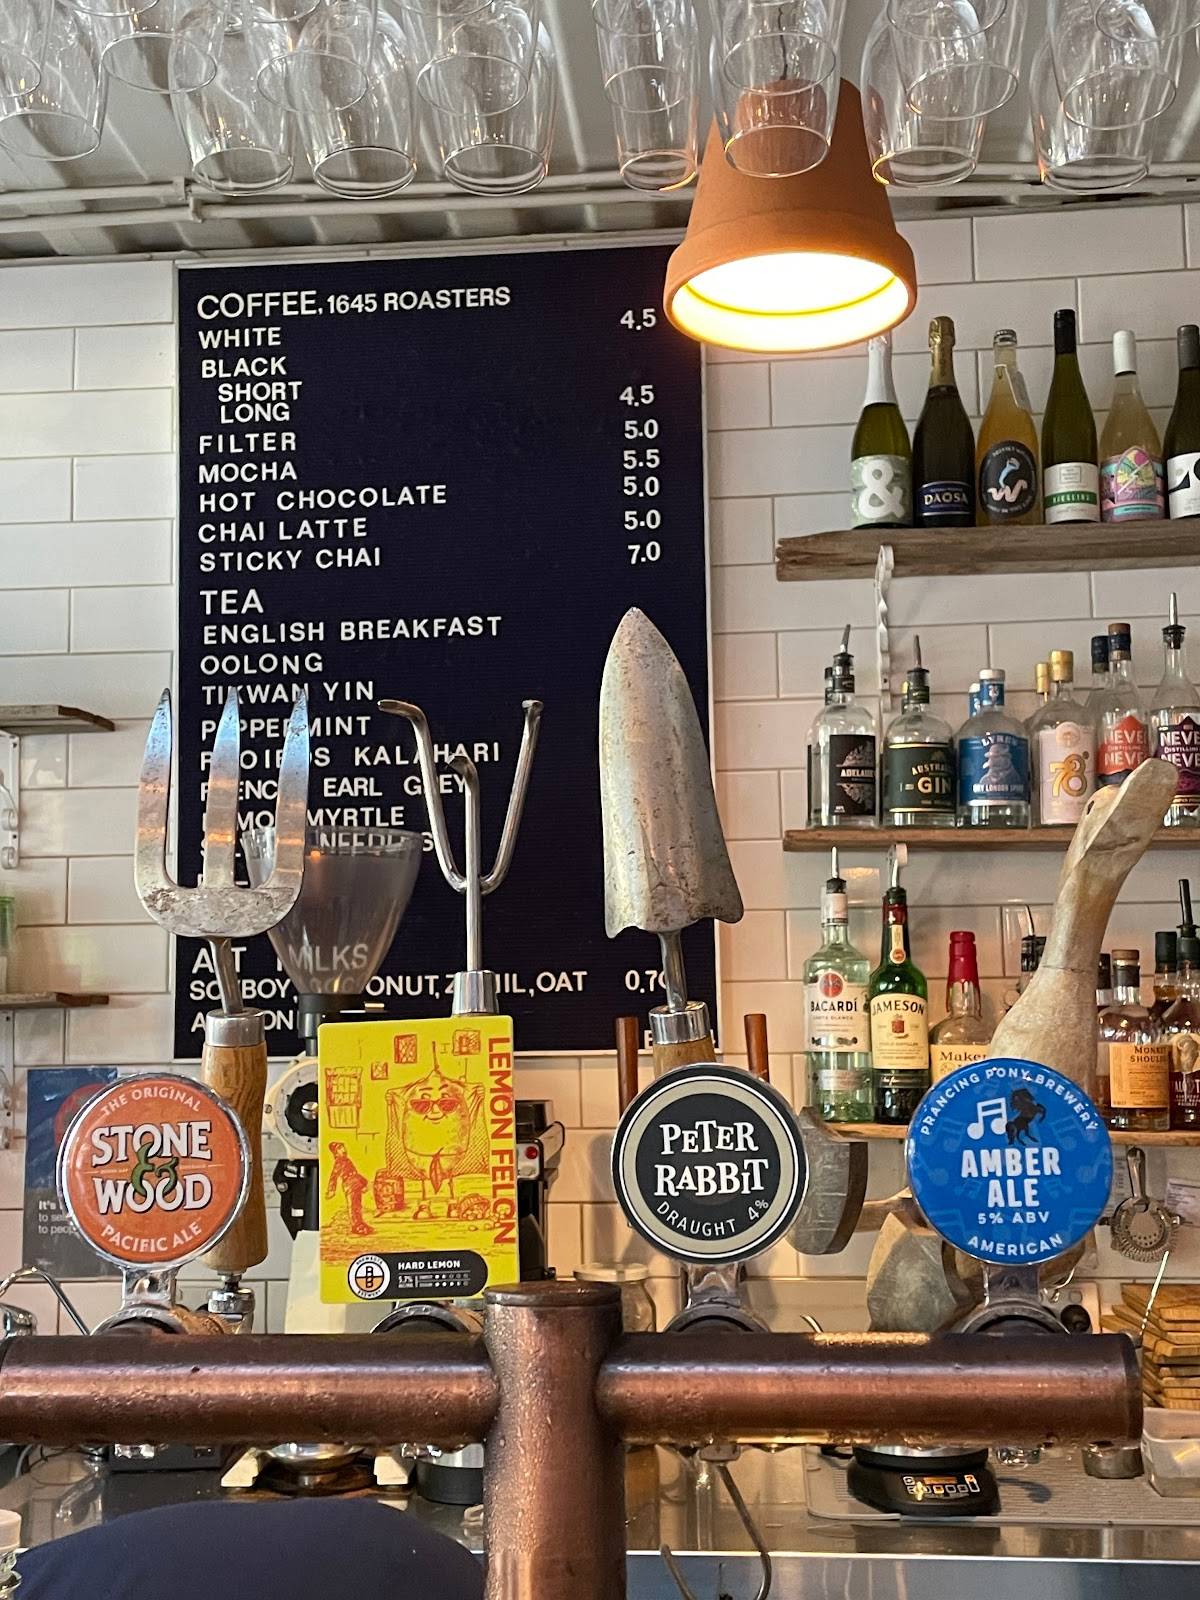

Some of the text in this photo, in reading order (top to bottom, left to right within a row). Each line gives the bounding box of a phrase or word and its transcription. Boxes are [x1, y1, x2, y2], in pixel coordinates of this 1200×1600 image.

[327, 294, 377, 313] 1645
[384, 287, 510, 311] ROASTERS
[621, 309, 655, 330] 4.5
[199, 327, 281, 349] WHITE
[202, 357, 286, 378] BLACK
[218, 381, 302, 401] SHORT
[620, 385, 654, 406] 4.5
[221, 403, 289, 423] LONG
[625, 419, 658, 439] 5.0
[200, 432, 295, 454] FILTER
[624, 449, 659, 469] 5.5
[199, 461, 297, 483] MOCHA
[624, 476, 659, 497] 5.0
[200, 485, 446, 512] HOT CHOCOLATE
[923, 492, 970, 505] DAOSA
[199, 518, 366, 543] CHAI LATTE
[625, 510, 660, 530] 5.0
[200, 548, 379, 571] STICKY CHAI
[628, 542, 660, 564] 7.0
[200, 589, 263, 614] TEA
[204, 616, 501, 644] ENGLISH BREAKFAST
[201, 653, 322, 674] OOLONG
[323, 681, 373, 701] YIN
[201, 714, 372, 741] PPEMINT
[1104, 729, 1147, 745] NEVE
[200, 746, 331, 771] ROIS
[200, 773, 467, 802] FNC EARL GEY
[917, 776, 951, 794] GIN
[306, 806, 405, 828] MYRTLE
[191, 946, 248, 974] AT
[189, 978, 299, 1003] SOBOY,
[872, 1000, 925, 1016] JAMESON
[488, 1037, 513, 1140] LEMON
[101, 1086, 201, 1116] THE ORIGINAL
[920, 1073, 980, 1136] PRANCING
[1035, 1073, 1099, 1132] BREWERY
[91, 1120, 212, 1168] STONE
[961, 1147, 1062, 1178] AMBER
[91, 1173, 212, 1215] WOOD
[987, 1178, 1040, 1208] ALE
[656, 1199, 770, 1237] DRAUGHT 4%
[1012, 1211, 1050, 1224] ABV
[101, 1220, 203, 1253] PACIFIC ALE
[967, 1233, 1063, 1256] AMERICAN
[397, 1260, 461, 1271] HARD LEMON
